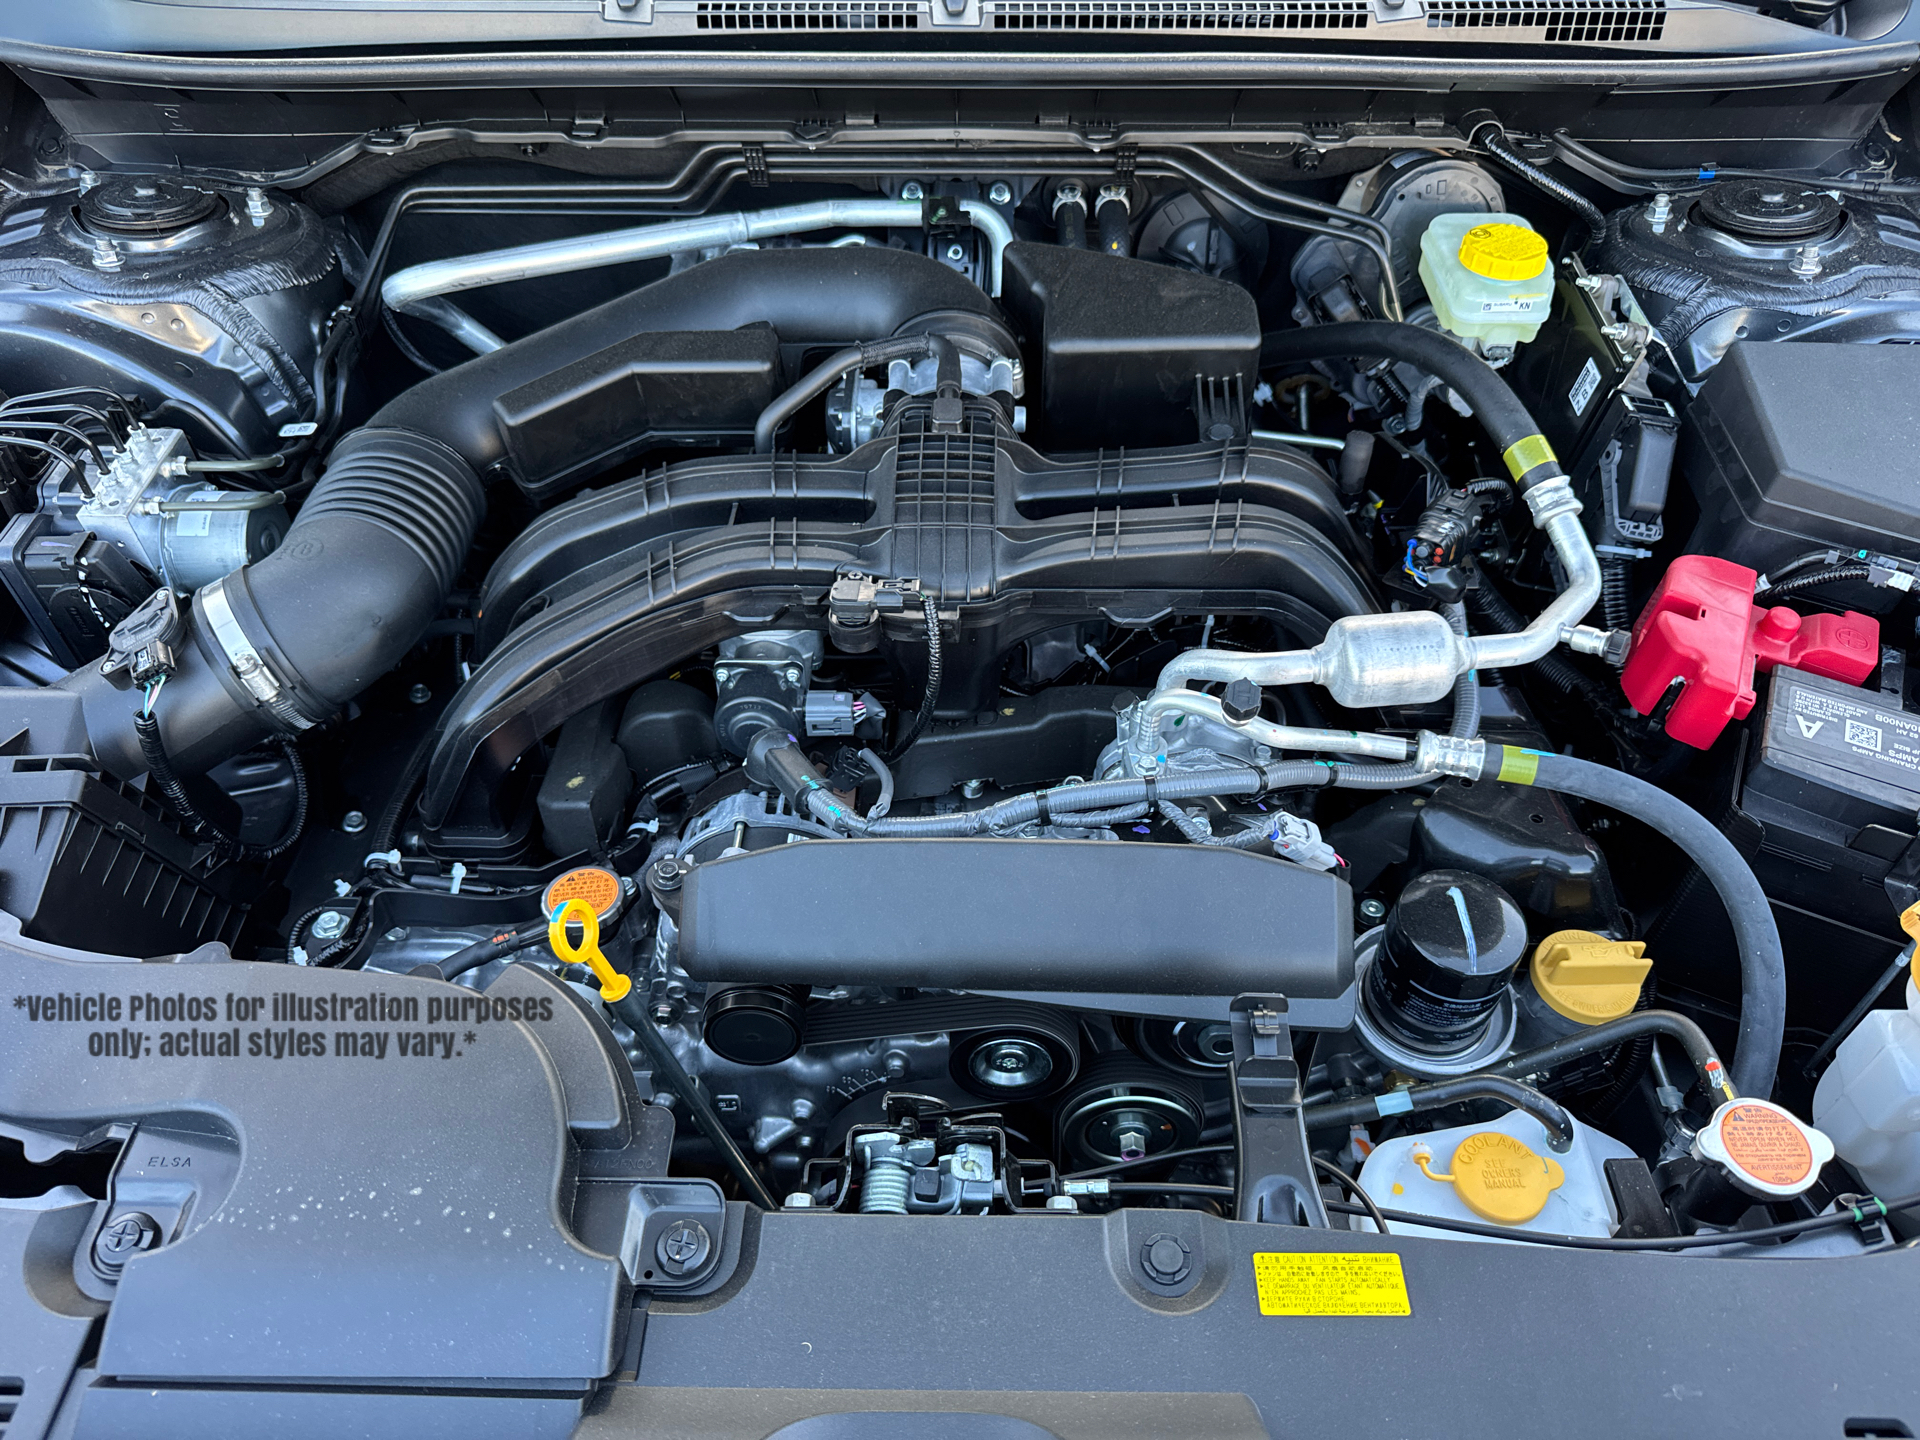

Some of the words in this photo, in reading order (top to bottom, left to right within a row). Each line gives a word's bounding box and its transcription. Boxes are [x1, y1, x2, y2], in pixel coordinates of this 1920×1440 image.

[1519, 302, 1531, 310] KN
[1802, 708, 1838, 723] DISTRIBUTED
[1896, 727, 1908, 736] AH
[1852, 745, 1874, 757] AMPS
[1893, 742, 1911, 753] SIZE
[1875, 752, 1917, 770] CRANKING
[1888, 749, 1920, 764] AMPS
[1542, 931, 1584, 951] ENGINE
[1555, 989, 1572, 1003] SEE
[1458, 1135, 1535, 1165] COOLANT
[147, 1156, 191, 1168] ELSA
[1484, 1159, 1507, 1168] SEE
[1484, 1179, 1527, 1190] MANUAL
[1282, 1255, 1307, 1264] CAUTION
[1309, 1255, 1339, 1264] ATTENTION
